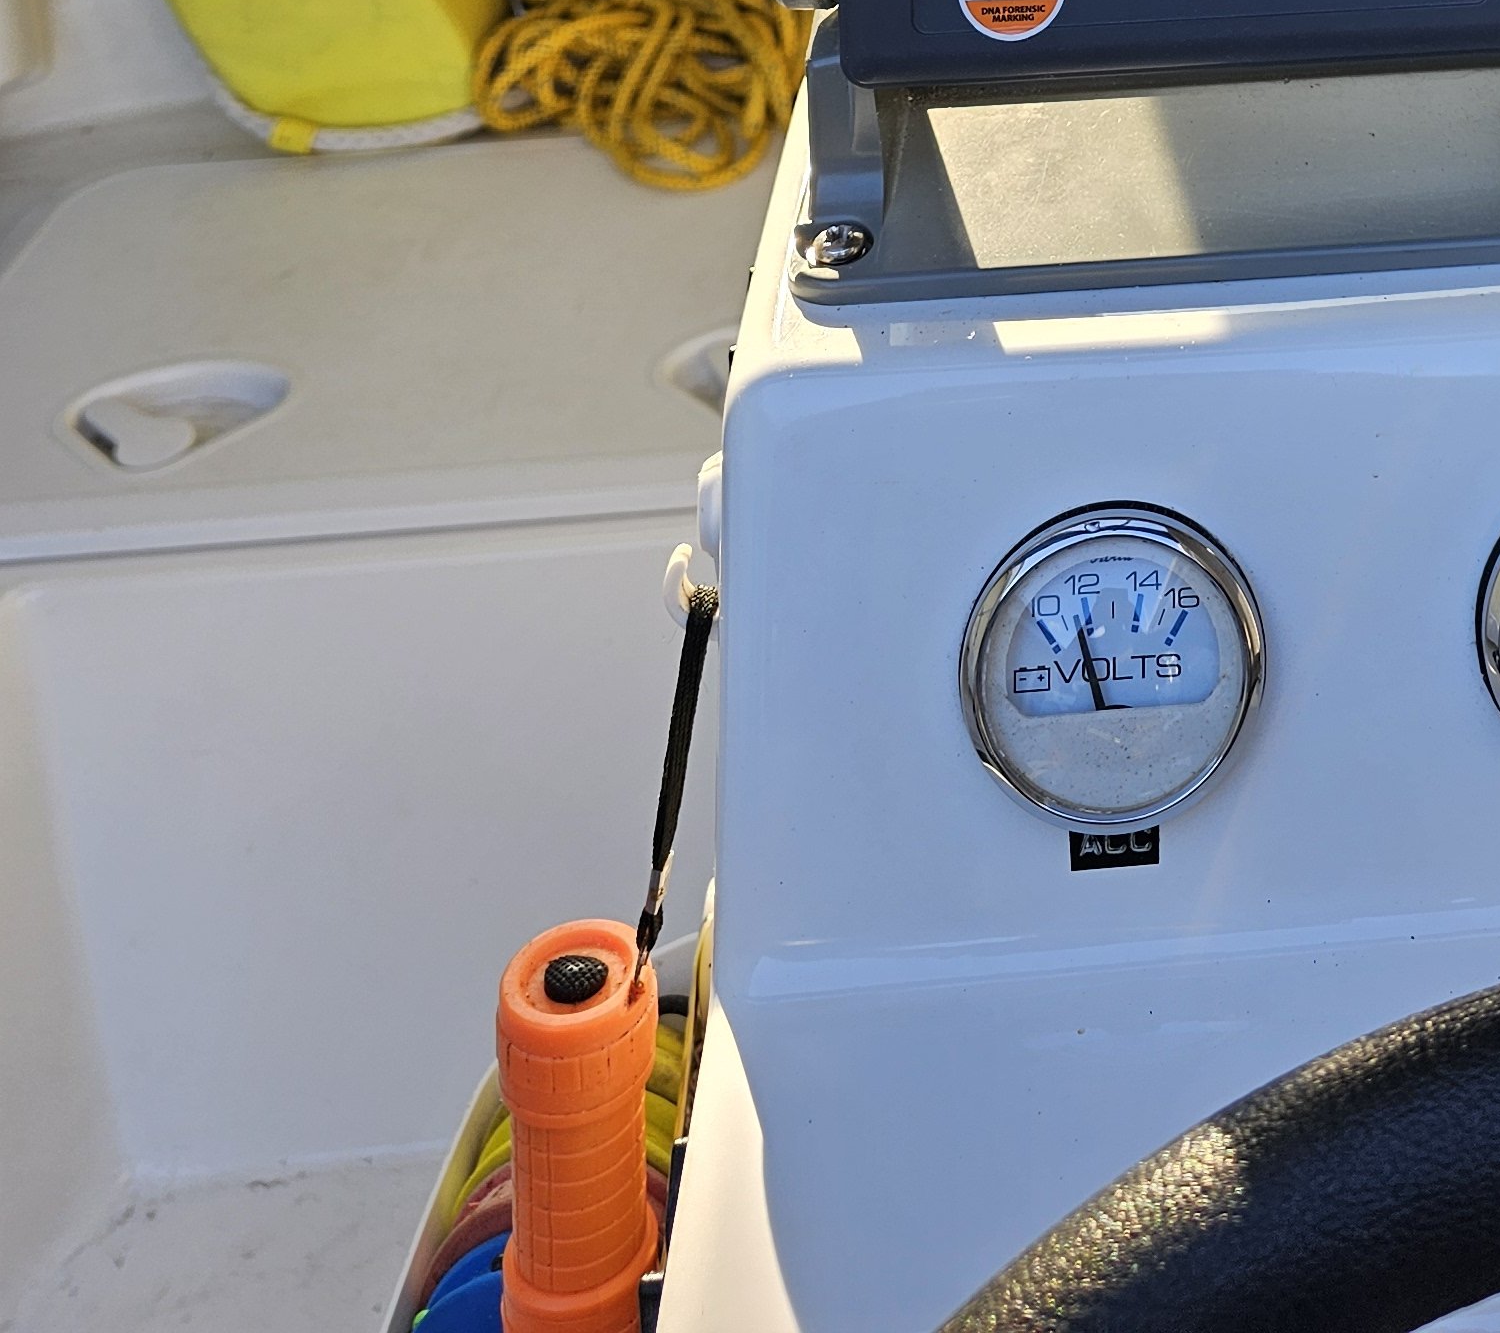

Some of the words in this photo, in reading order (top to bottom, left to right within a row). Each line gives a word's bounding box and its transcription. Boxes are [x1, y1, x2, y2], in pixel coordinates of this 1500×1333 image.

[982, 7, 1000, 15] DNA
[1003, 5, 1045, 14] FORENSIC
[992, 14, 1034, 22] MARKING
[1064, 573, 1100, 595] 12
[1126, 569, 1161, 592] 14
[1164, 586, 1199, 608] 16
[1054, 653, 1182, 684] VOLTS
